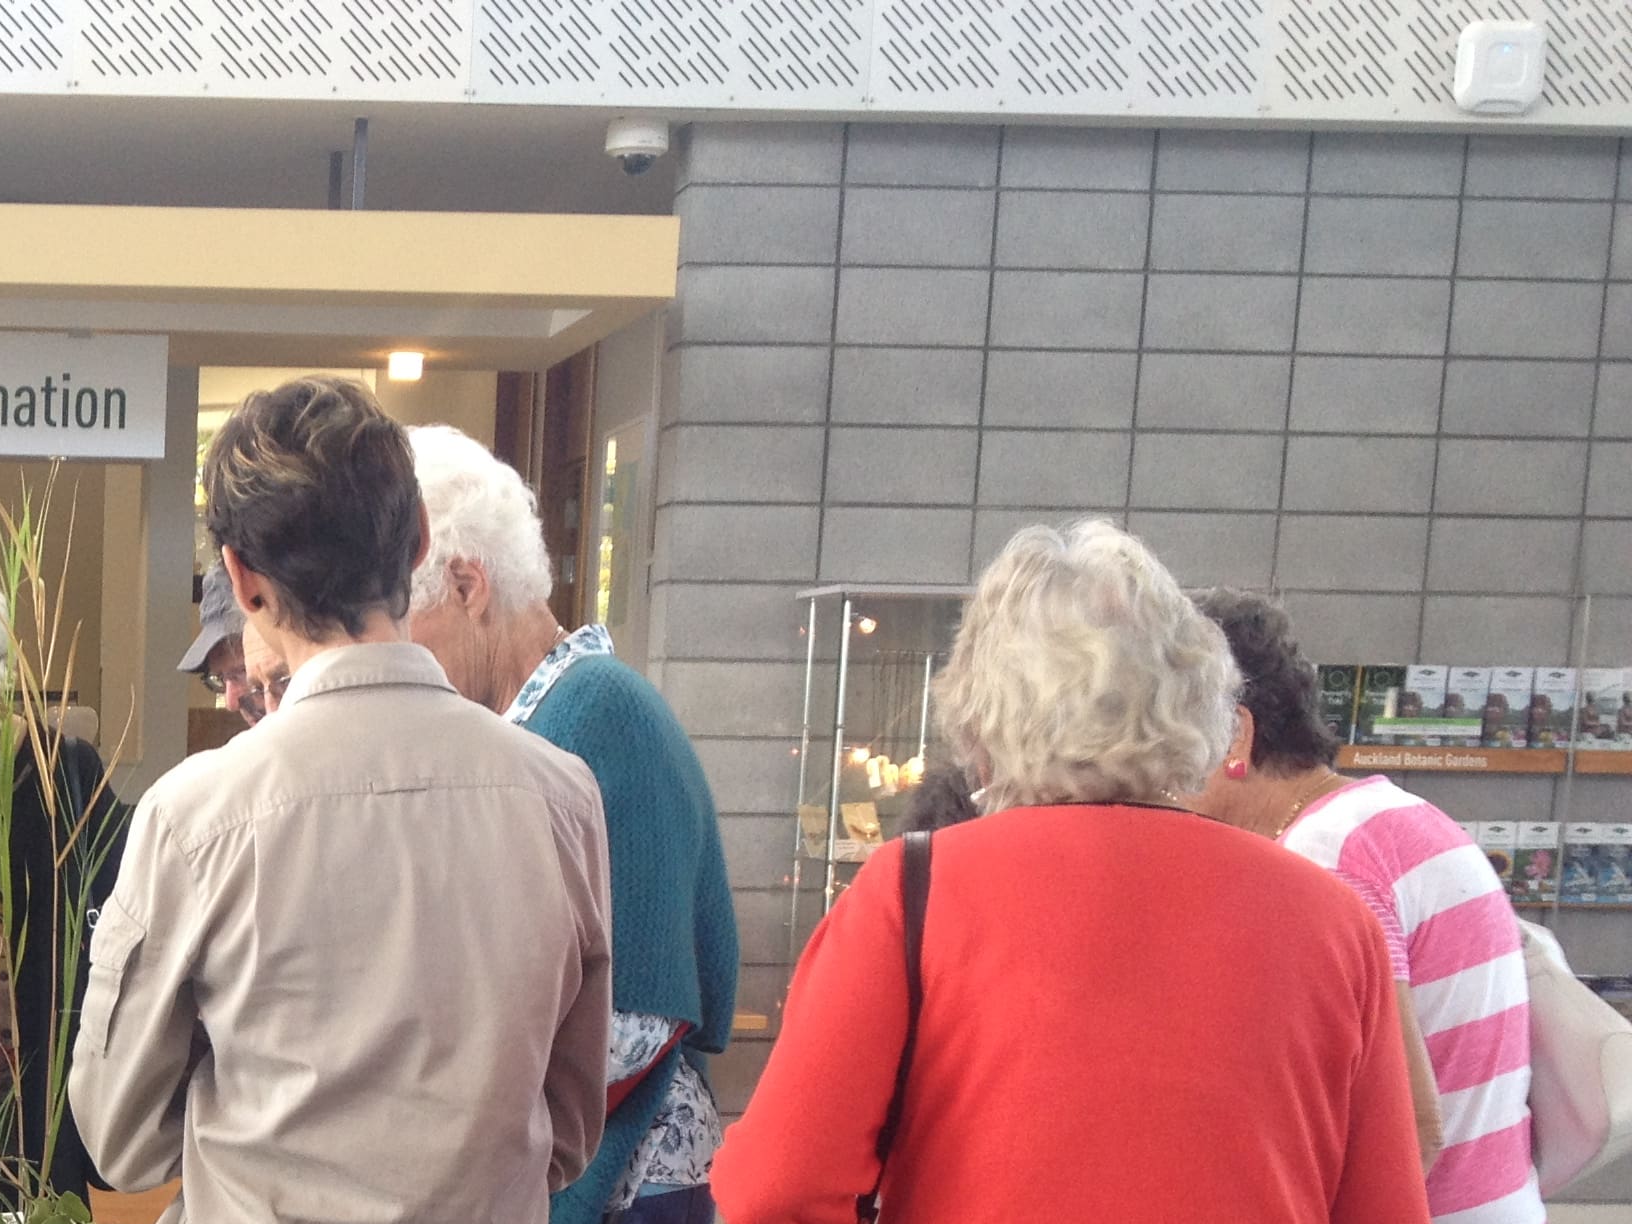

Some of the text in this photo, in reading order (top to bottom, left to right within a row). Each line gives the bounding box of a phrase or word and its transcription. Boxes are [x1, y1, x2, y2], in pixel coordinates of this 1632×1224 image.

[1354, 752, 1488, 768] Auckland Botanic Gardens
